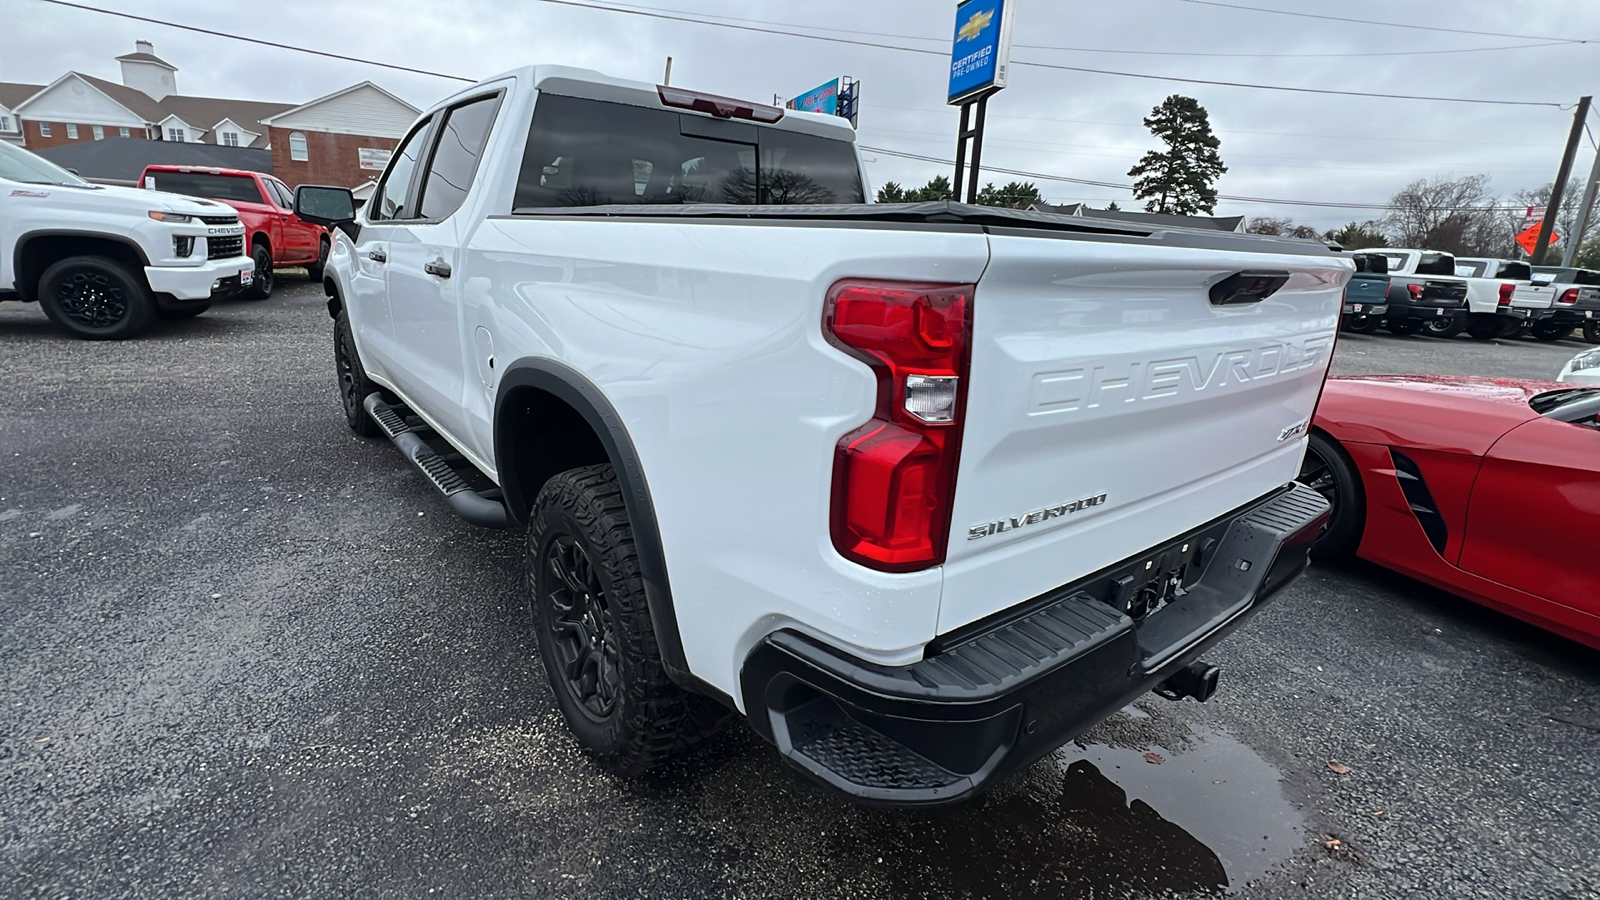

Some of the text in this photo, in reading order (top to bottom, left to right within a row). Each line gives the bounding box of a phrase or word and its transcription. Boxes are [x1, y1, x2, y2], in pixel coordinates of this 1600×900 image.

[952, 45, 992, 71] CERTIFIED
[953, 56, 989, 79] PRE-OWNED
[967, 492, 1107, 541] SILVERADO
